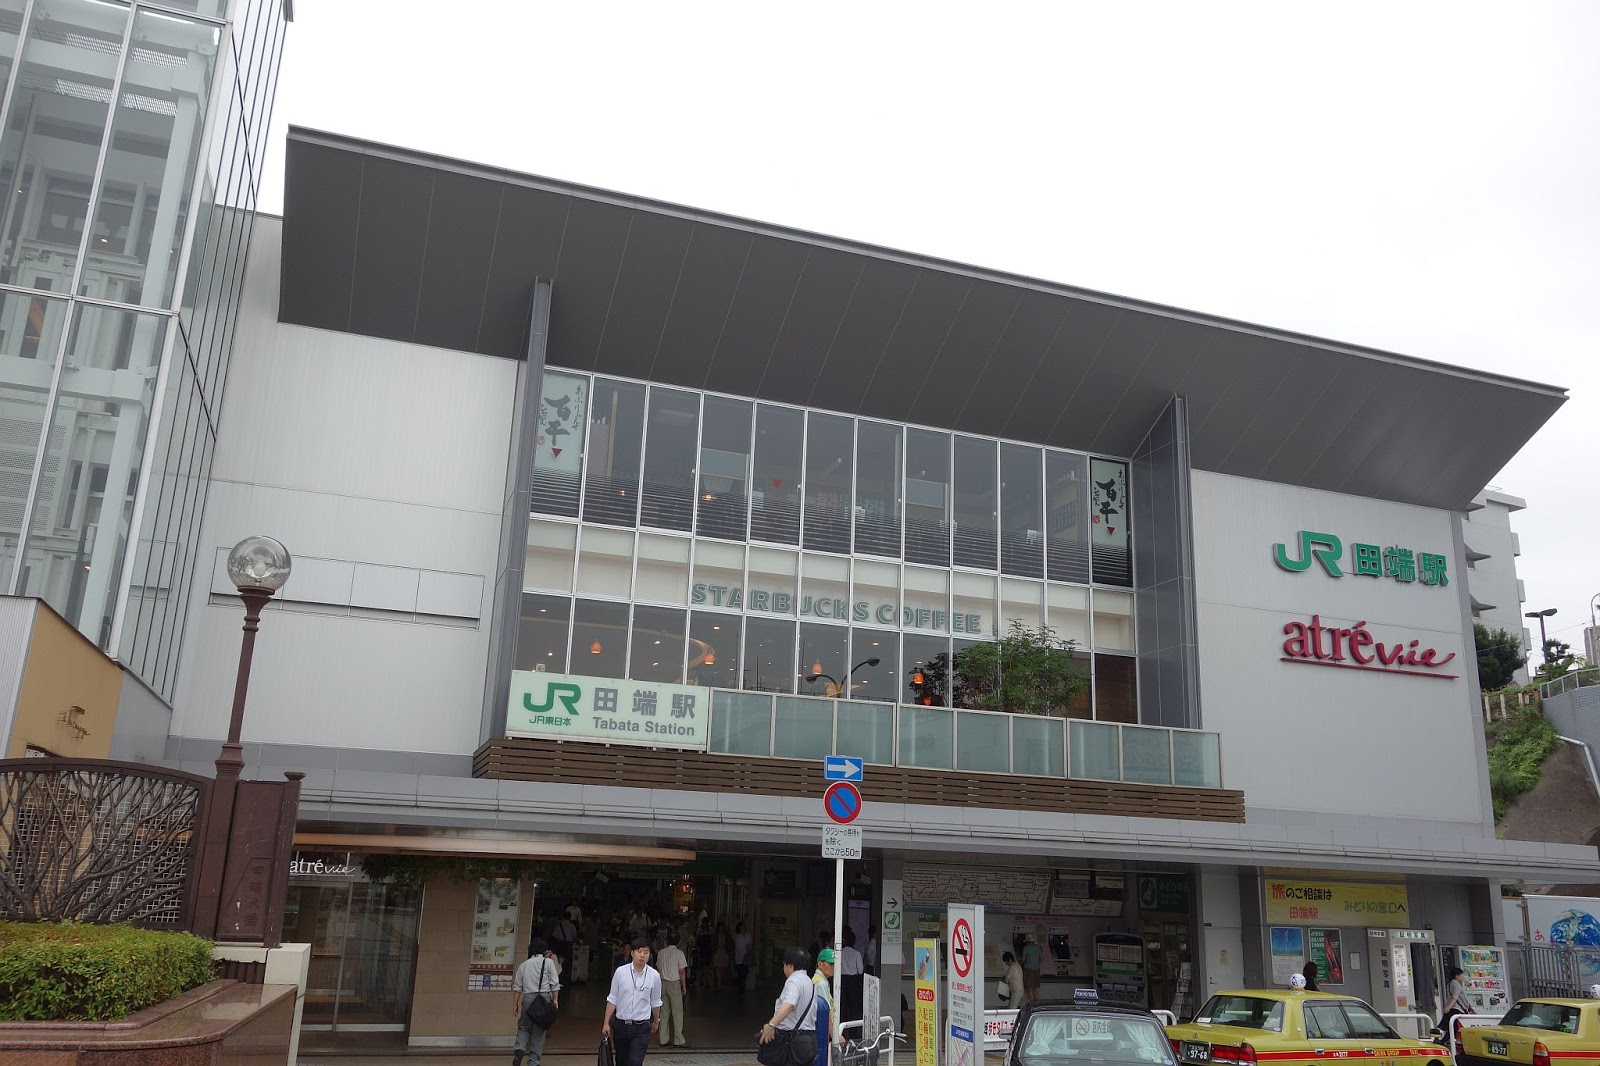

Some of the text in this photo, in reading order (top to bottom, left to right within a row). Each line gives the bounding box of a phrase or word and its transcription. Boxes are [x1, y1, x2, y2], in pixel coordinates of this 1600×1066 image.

[1273, 530, 1449, 586] JR 田端駅
[691, 582, 982, 634] STARBUCKS COFFEE
[523, 682, 696, 720] JR 田端駅
[529, 715, 572, 727] JR東日本
[593, 716, 695, 736] Tabata Station
[1271, 882, 1333, 900] 旅のご相談は
[1289, 906, 1319, 919] 田端駅
[1344, 901, 1406, 914] みどりの窓口へ
[1380, 948, 1390, 989] 証明写真
[1190, 1050, 1208, 1060] 97-68
